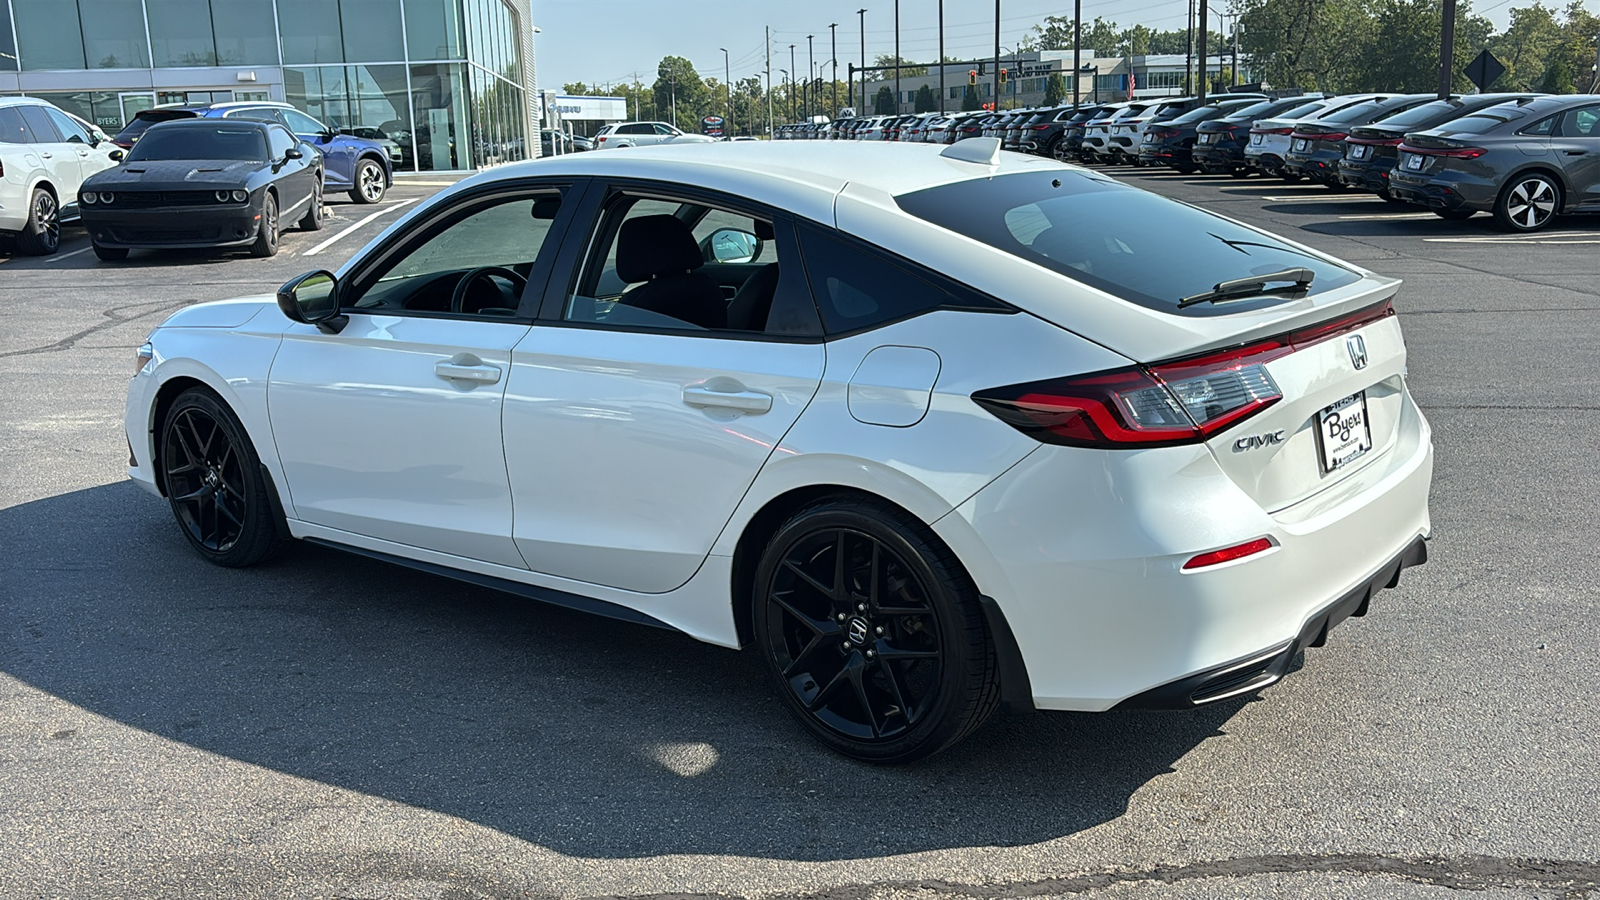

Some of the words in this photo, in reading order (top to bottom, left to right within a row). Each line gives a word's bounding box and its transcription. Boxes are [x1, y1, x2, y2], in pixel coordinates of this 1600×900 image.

[97, 117, 118, 125] BYERS
[1323, 412, 1361, 442] Byers
[1235, 430, 1285, 449] CIVIC
